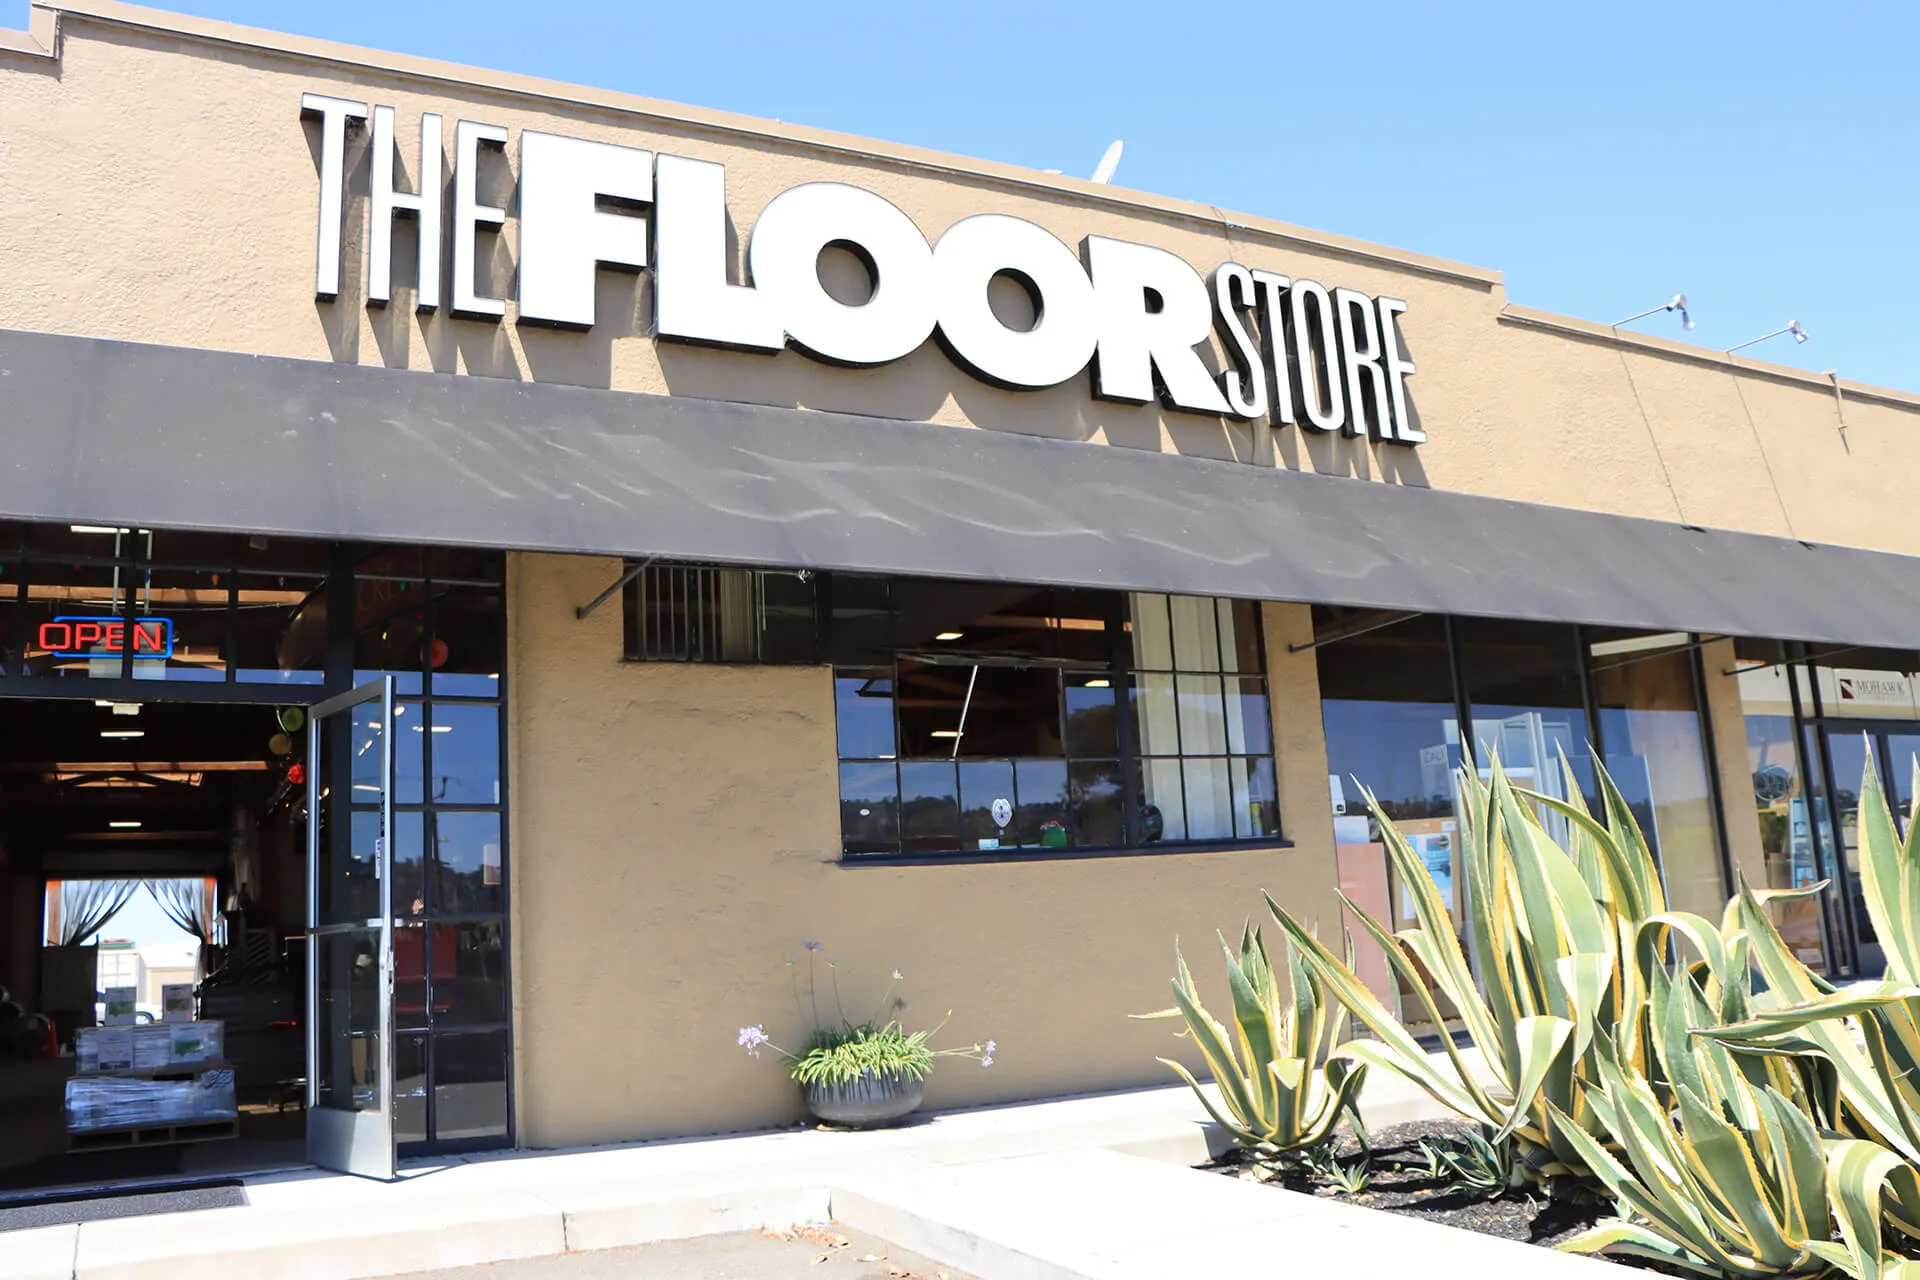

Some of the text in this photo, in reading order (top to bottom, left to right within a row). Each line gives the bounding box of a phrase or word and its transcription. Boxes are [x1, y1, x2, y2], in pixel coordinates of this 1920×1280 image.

[300, 92, 1427, 445] THE FLOOR STORE
[39, 622, 162, 652] OPEN
[1856, 679, 1905, 696] MOHAWK
